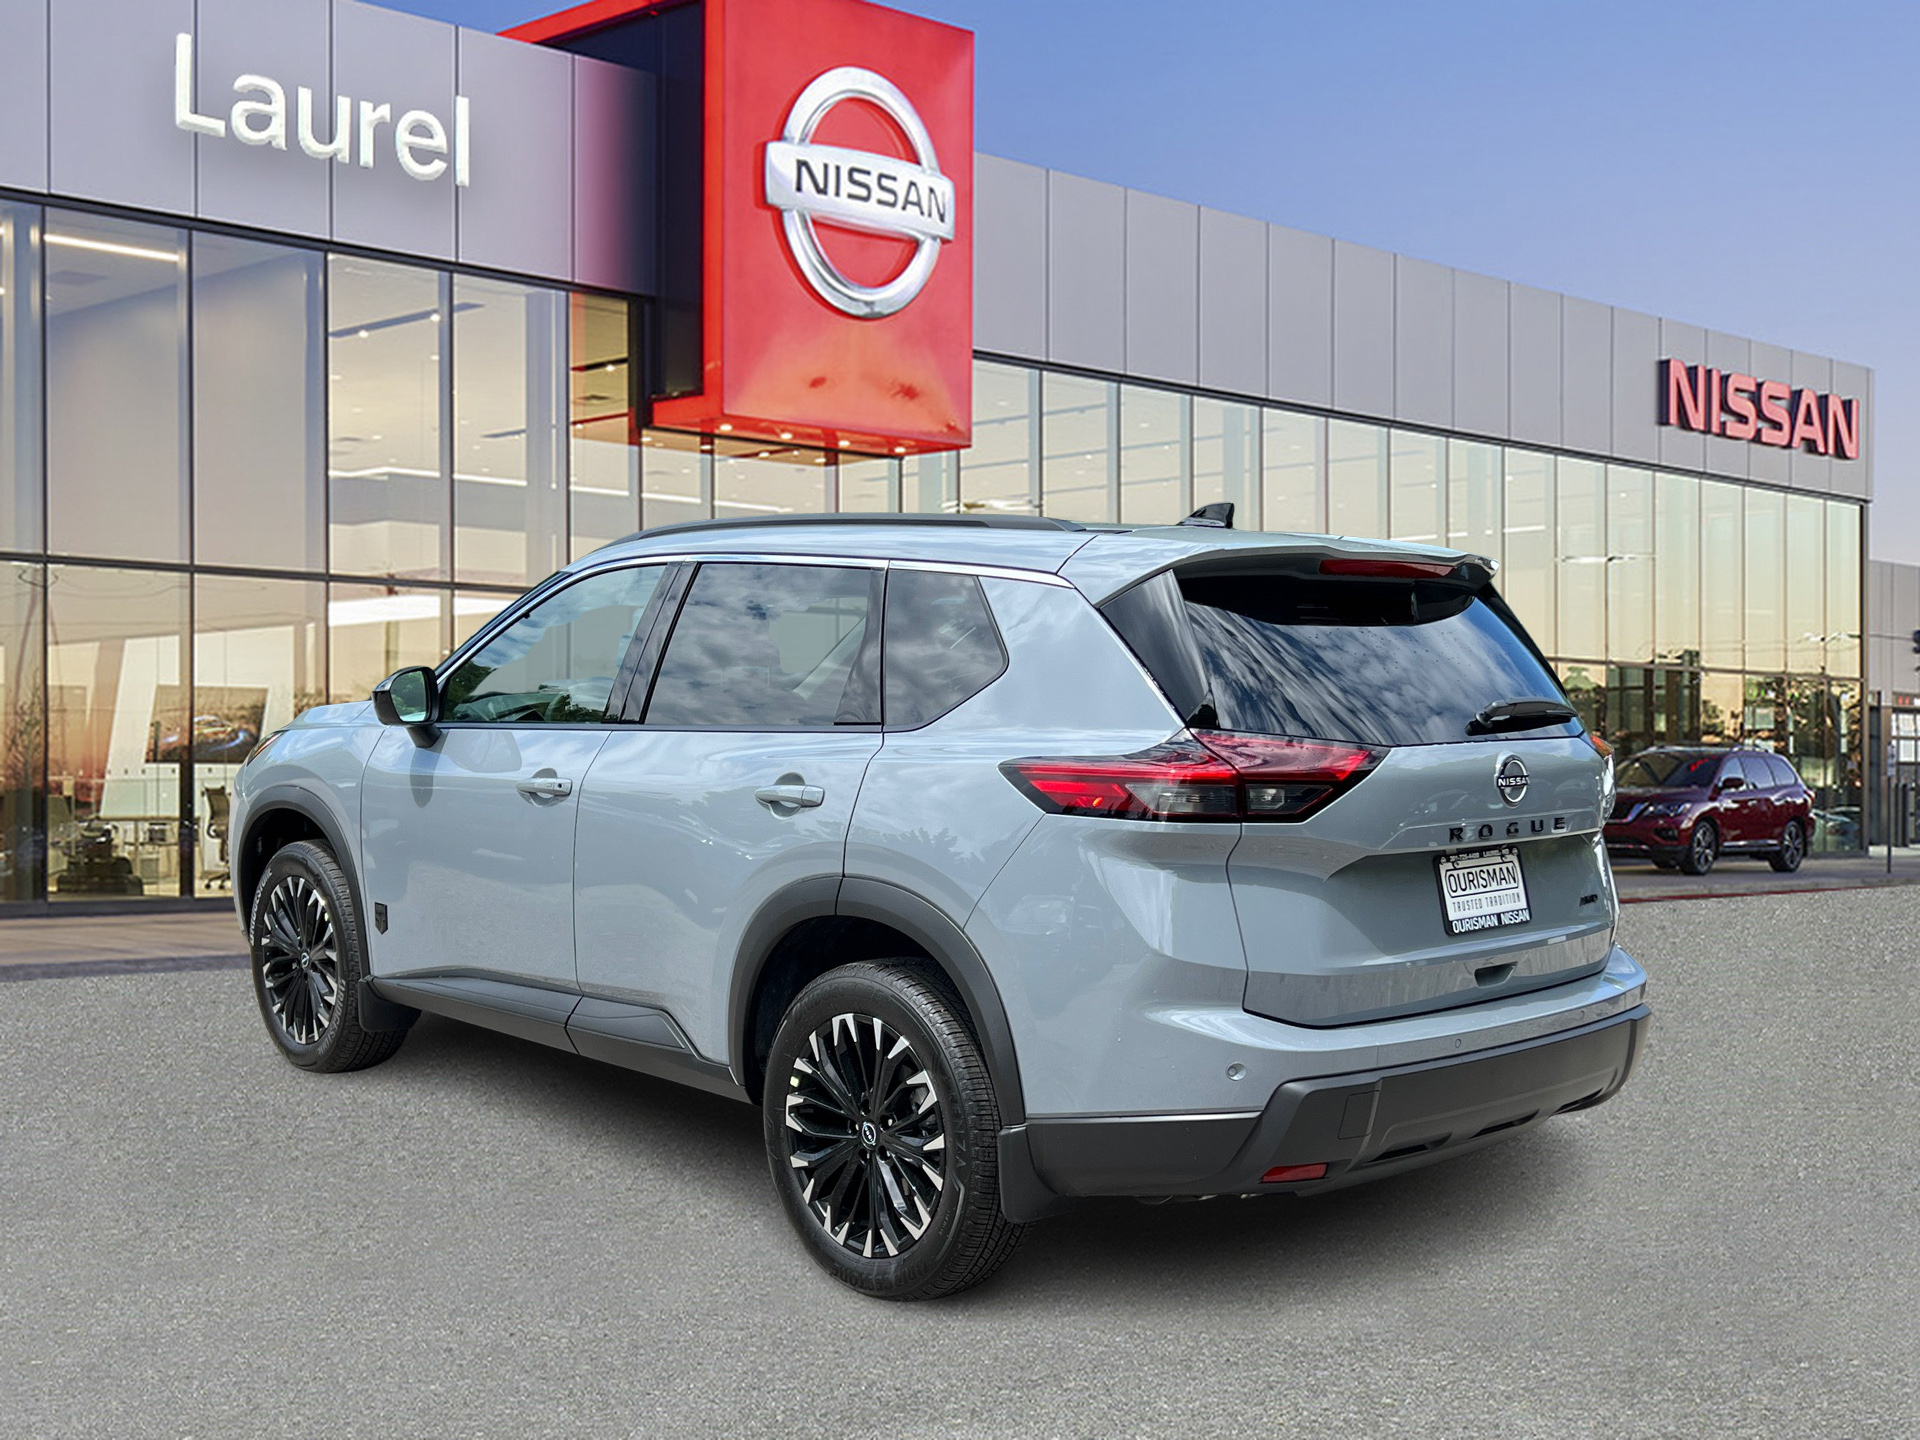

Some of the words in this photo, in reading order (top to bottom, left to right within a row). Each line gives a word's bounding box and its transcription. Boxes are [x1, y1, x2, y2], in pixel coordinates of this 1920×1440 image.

[175, 33, 470, 187] Laurel
[795, 159, 946, 223] NISSAN
[1659, 358, 1859, 459] NISSAN
[1449, 817, 1566, 842] ROGUE
[1448, 866, 1517, 893] OURISMAN
[1452, 898, 1483, 912] TRUSTED
[1485, 892, 1521, 908] TRADITION
[1452, 914, 1499, 934] OURISMAN
[1500, 909, 1531, 926] NISSAN
